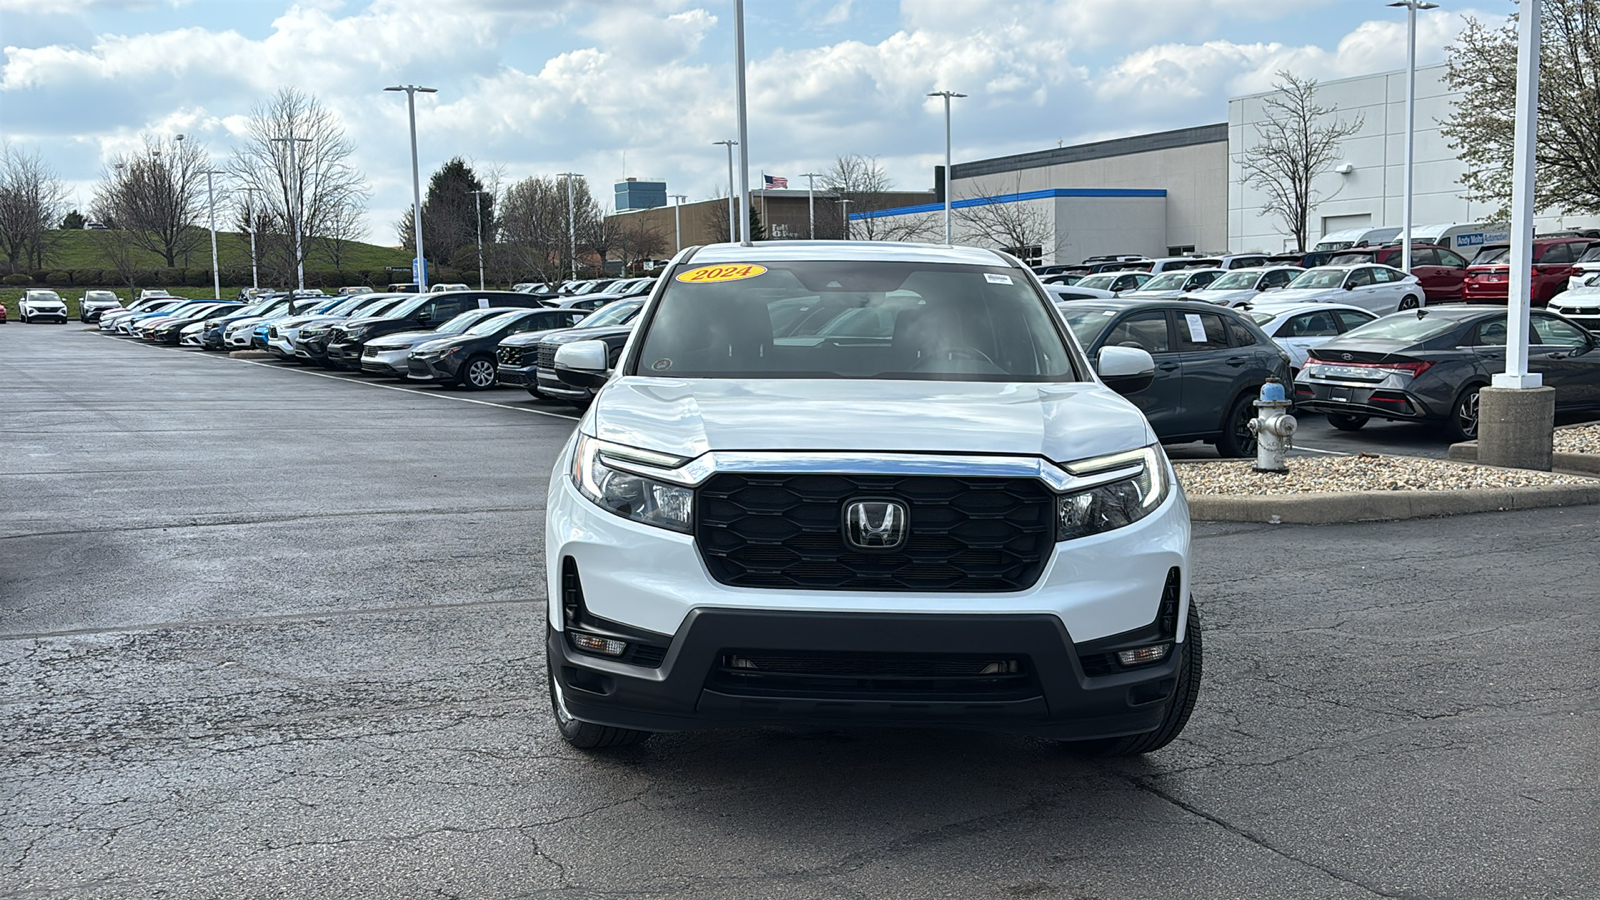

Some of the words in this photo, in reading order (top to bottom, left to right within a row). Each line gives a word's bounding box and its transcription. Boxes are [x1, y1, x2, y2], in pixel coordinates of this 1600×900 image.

[1458, 236, 1470, 245] Andy
[1471, 234, 1483, 243] Mohr
[691, 266, 753, 281] 2024
